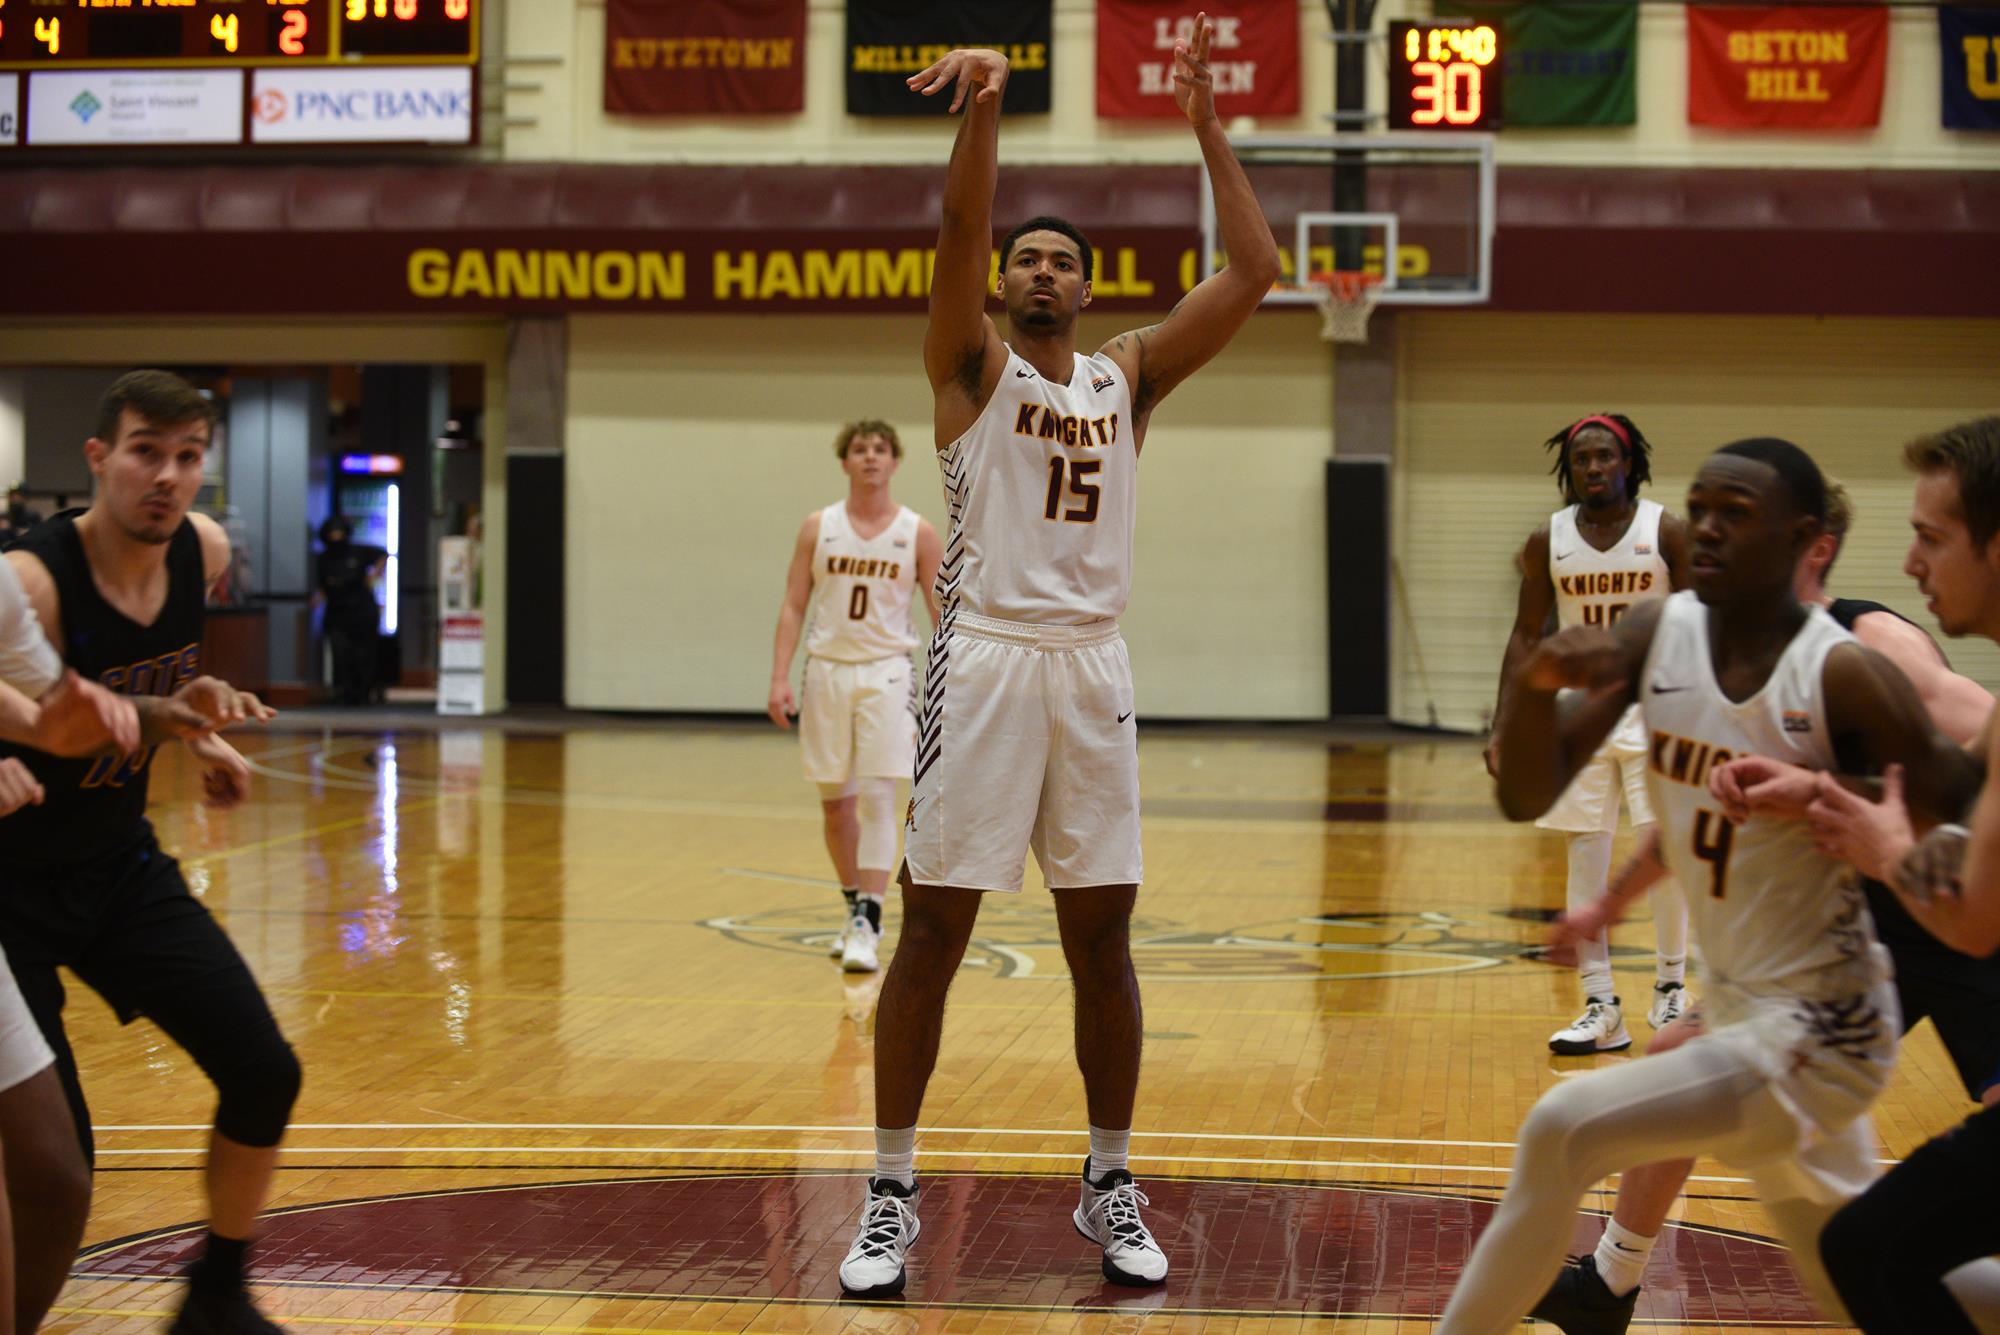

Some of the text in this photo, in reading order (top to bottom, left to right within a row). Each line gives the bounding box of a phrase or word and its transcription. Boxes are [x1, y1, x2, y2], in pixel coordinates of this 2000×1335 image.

[34, 16, 60, 54] 4
[210, 13, 239, 52] 4
[279, 9, 308, 55] 2
[1154, 16, 1241, 49] LOK
[1728, 31, 1848, 63] SETON
[614, 37, 794, 69] KUTZTOWN
[854, 43, 1046, 73] MILLELE
[1139, 61, 1256, 95] HAEN
[1411, 61, 1481, 124] 30
[1747, 69, 1830, 101] HILL
[295, 86, 471, 121] PNC BANK
[407, 248, 686, 299] GANNON
[713, 249, 1154, 298] HAMMLL
[1014, 401, 1119, 448] KNIGHTS
[1043, 454, 1103, 524] 15
[827, 556, 900, 580] KNIGHTS
[1559, 571, 1653, 596] KNIGHTS
[849, 584, 868, 621] 0
[1692, 807, 1735, 900] 4
